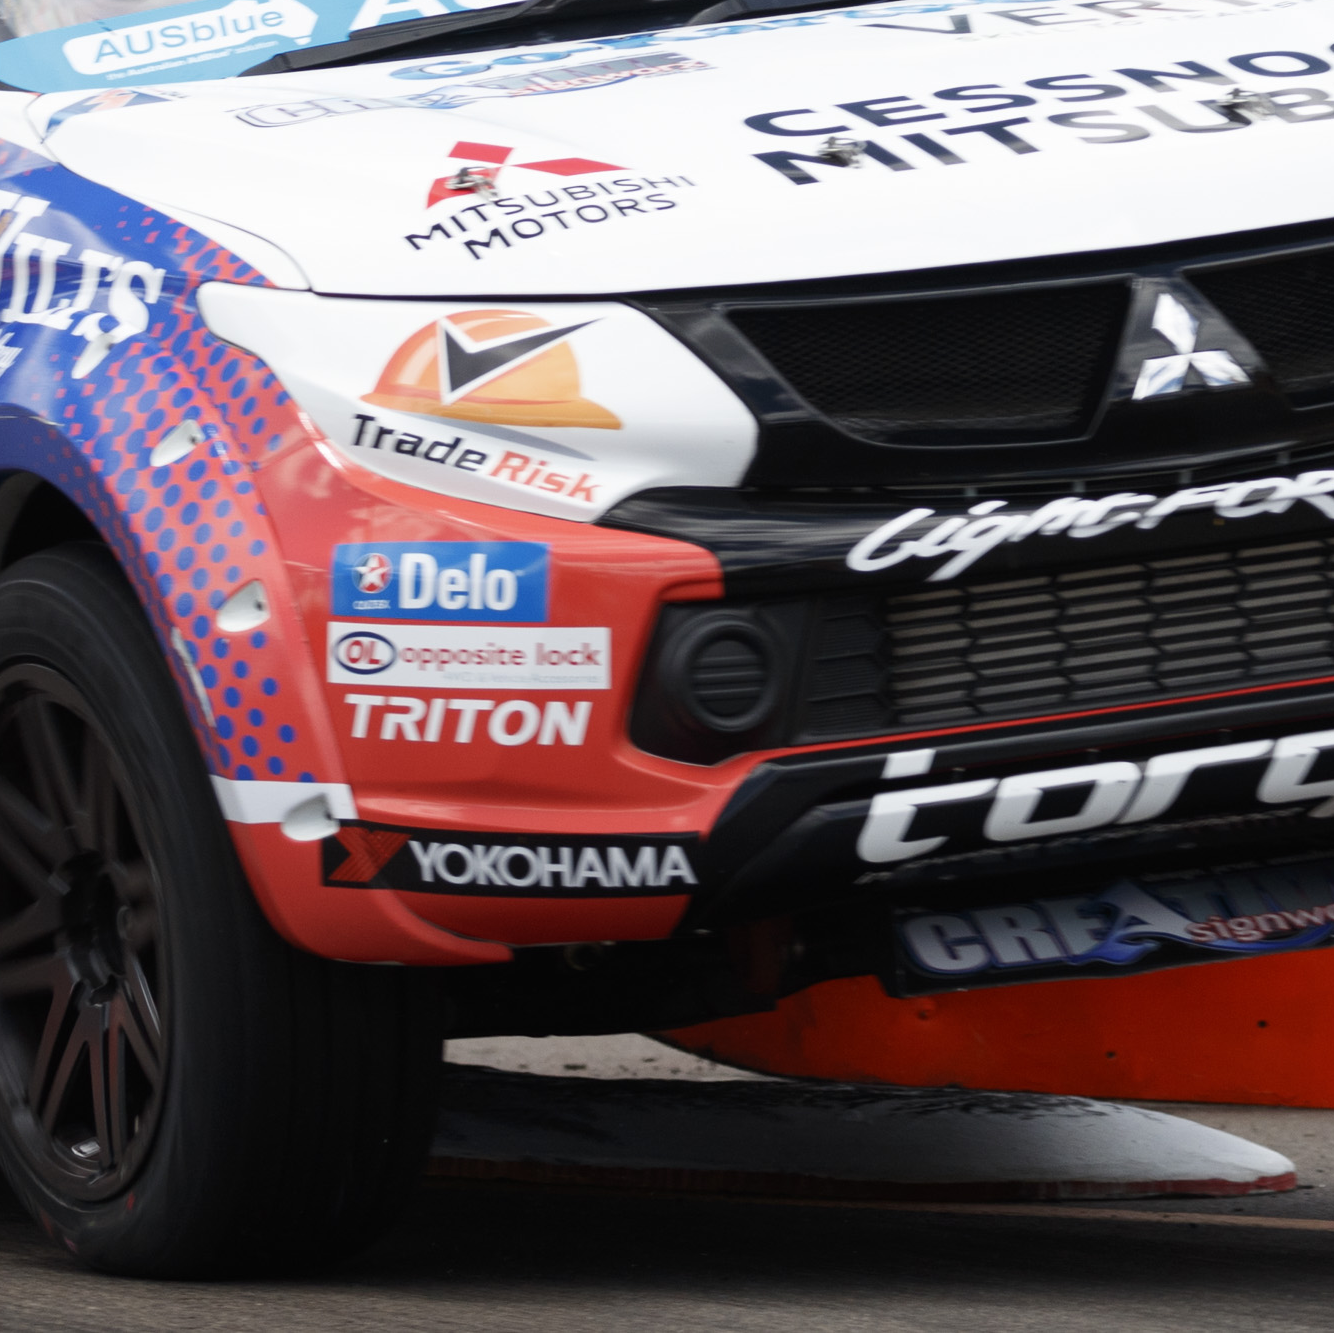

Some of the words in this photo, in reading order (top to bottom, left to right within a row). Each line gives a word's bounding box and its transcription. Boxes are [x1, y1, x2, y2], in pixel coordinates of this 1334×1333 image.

[94, 10, 286, 64] AUSblue
[403, 174, 697, 251] MITSUBISHI
[463, 192, 677, 261] MOTORS
[351, 413, 489, 472] Trade
[489, 449, 602, 503] Risk
[398, 552, 519, 612] Delo
[343, 638, 384, 665] OL
[398, 641, 528, 672] opposite
[535, 642, 604, 667] lock
[344, 693, 594, 747] TRITON
[408, 839, 700, 888] YOKOHAMA
